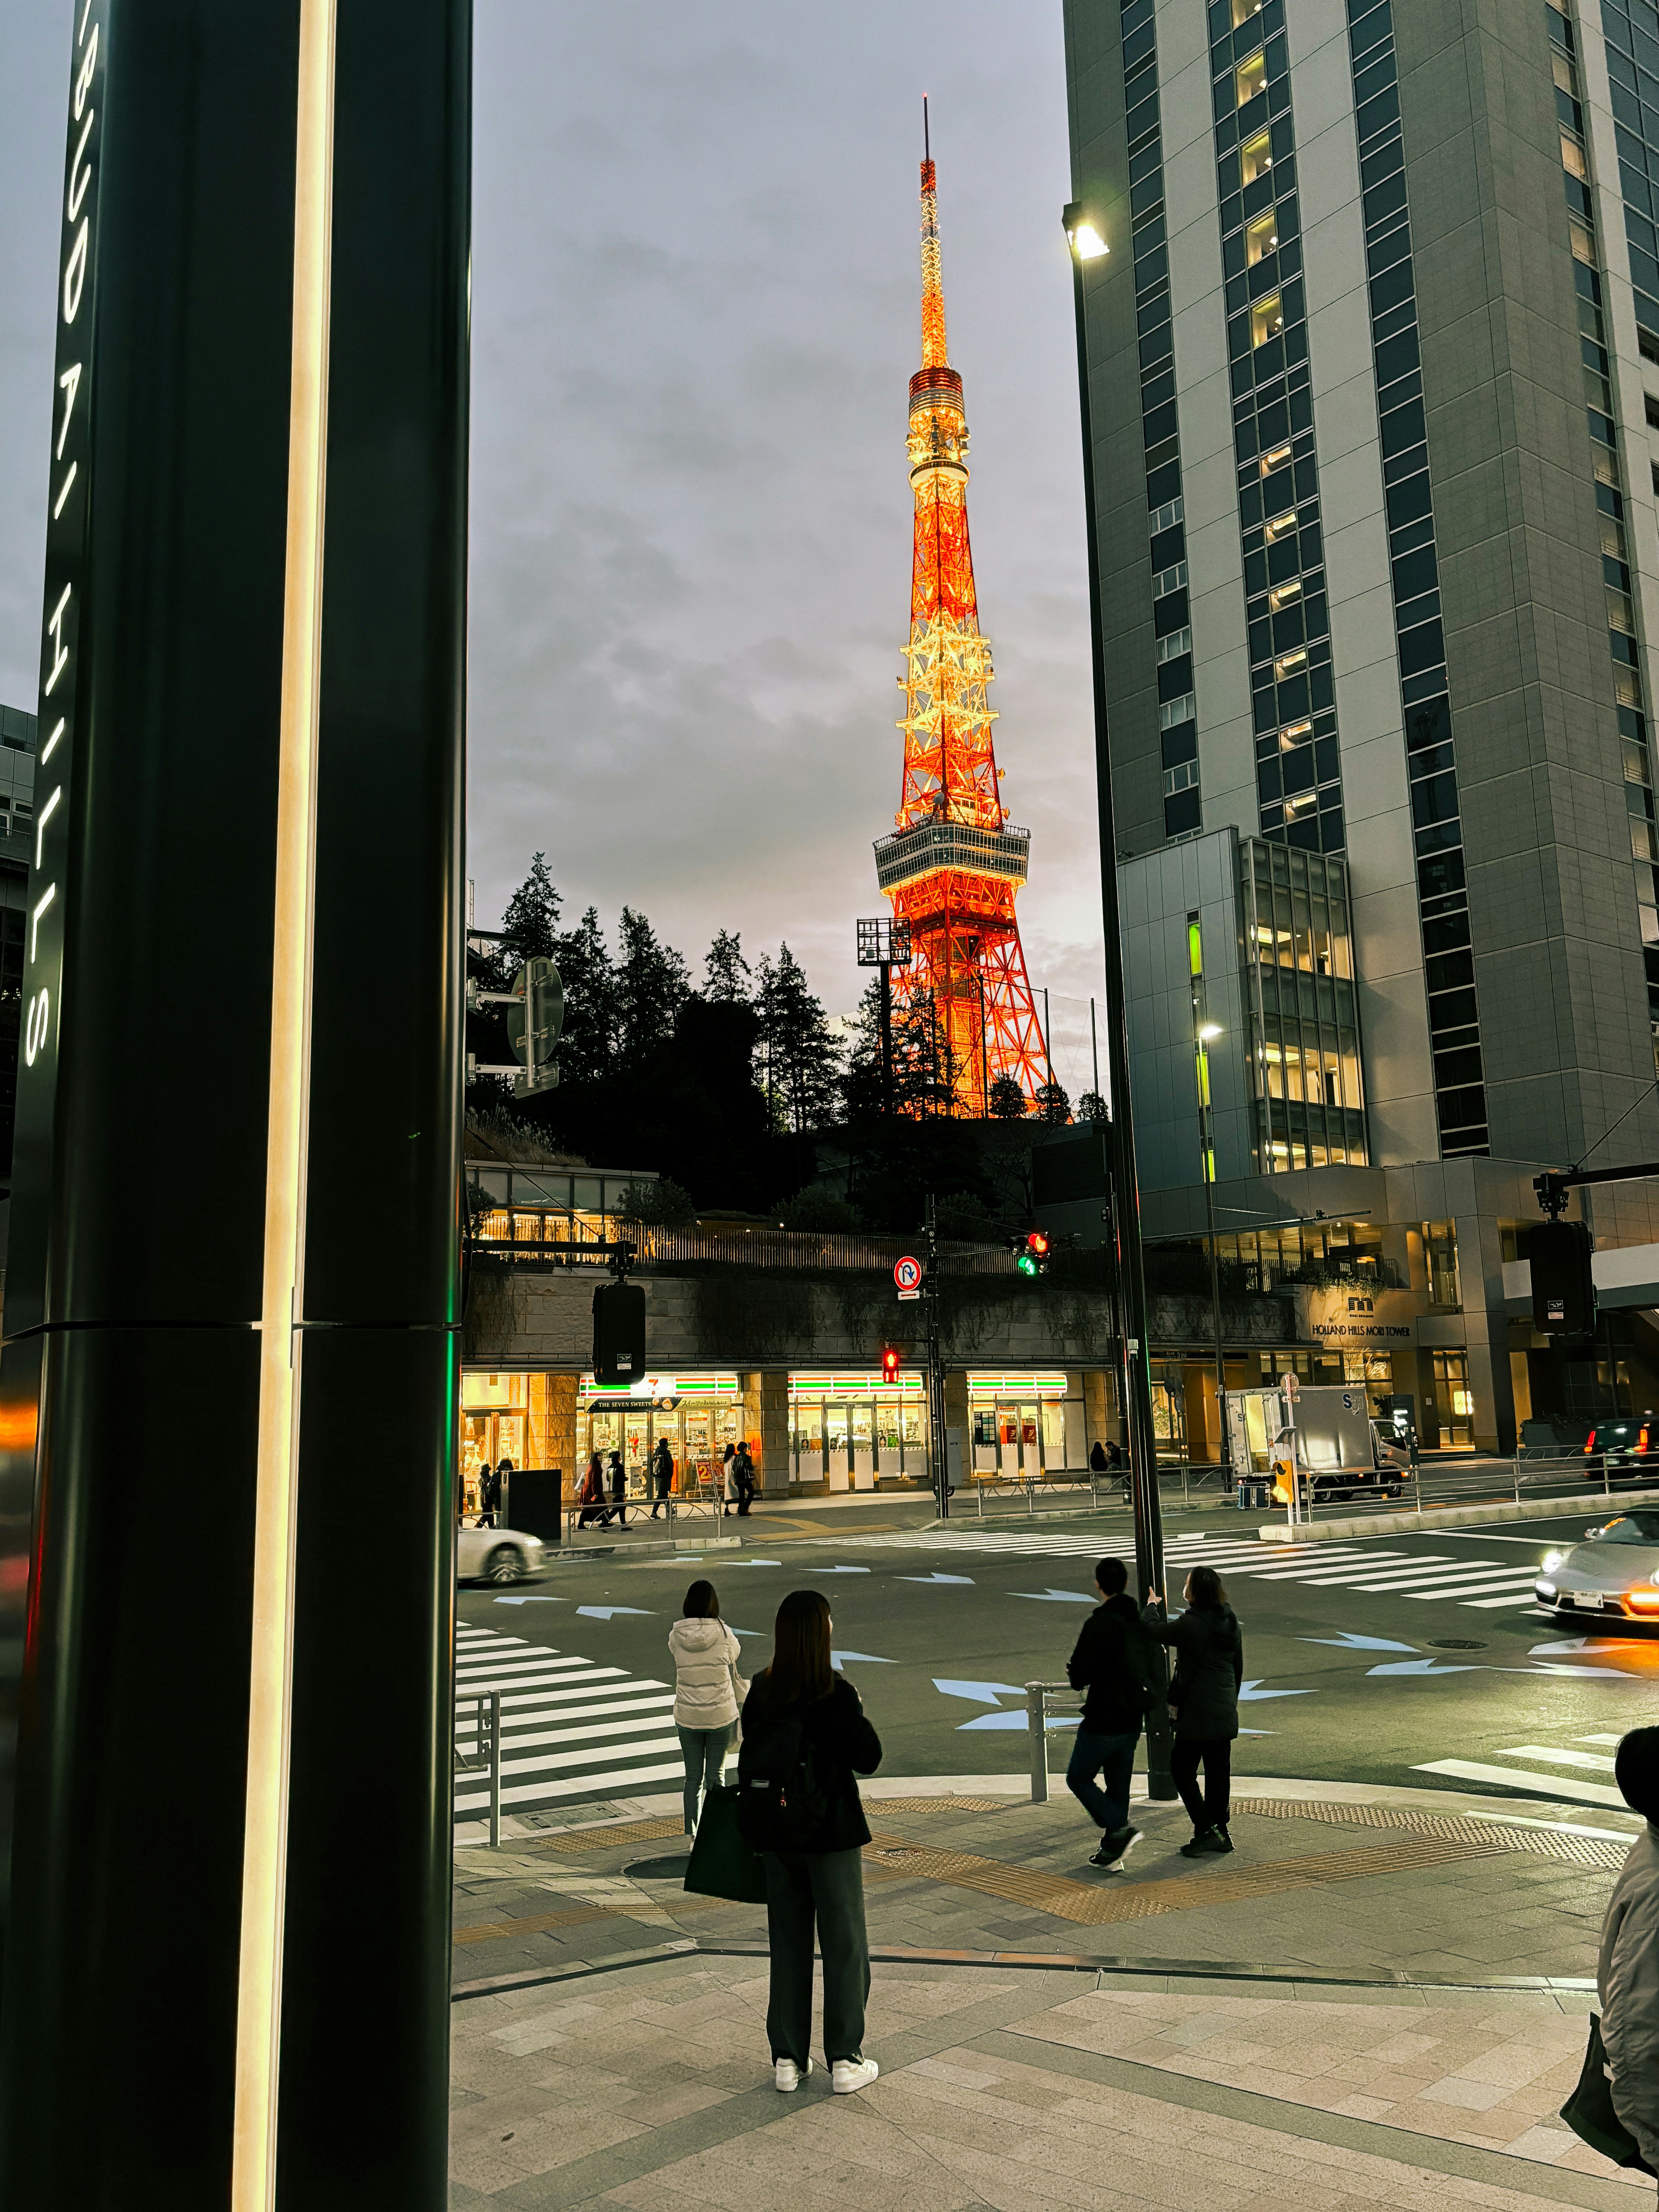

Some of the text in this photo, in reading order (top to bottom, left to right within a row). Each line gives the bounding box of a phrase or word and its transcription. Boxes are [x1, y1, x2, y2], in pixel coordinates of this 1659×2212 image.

[26, 582, 71, 1067] HILLS
[1312, 1325, 1410, 1336] HOLLAND HILLS MORI TOWER
